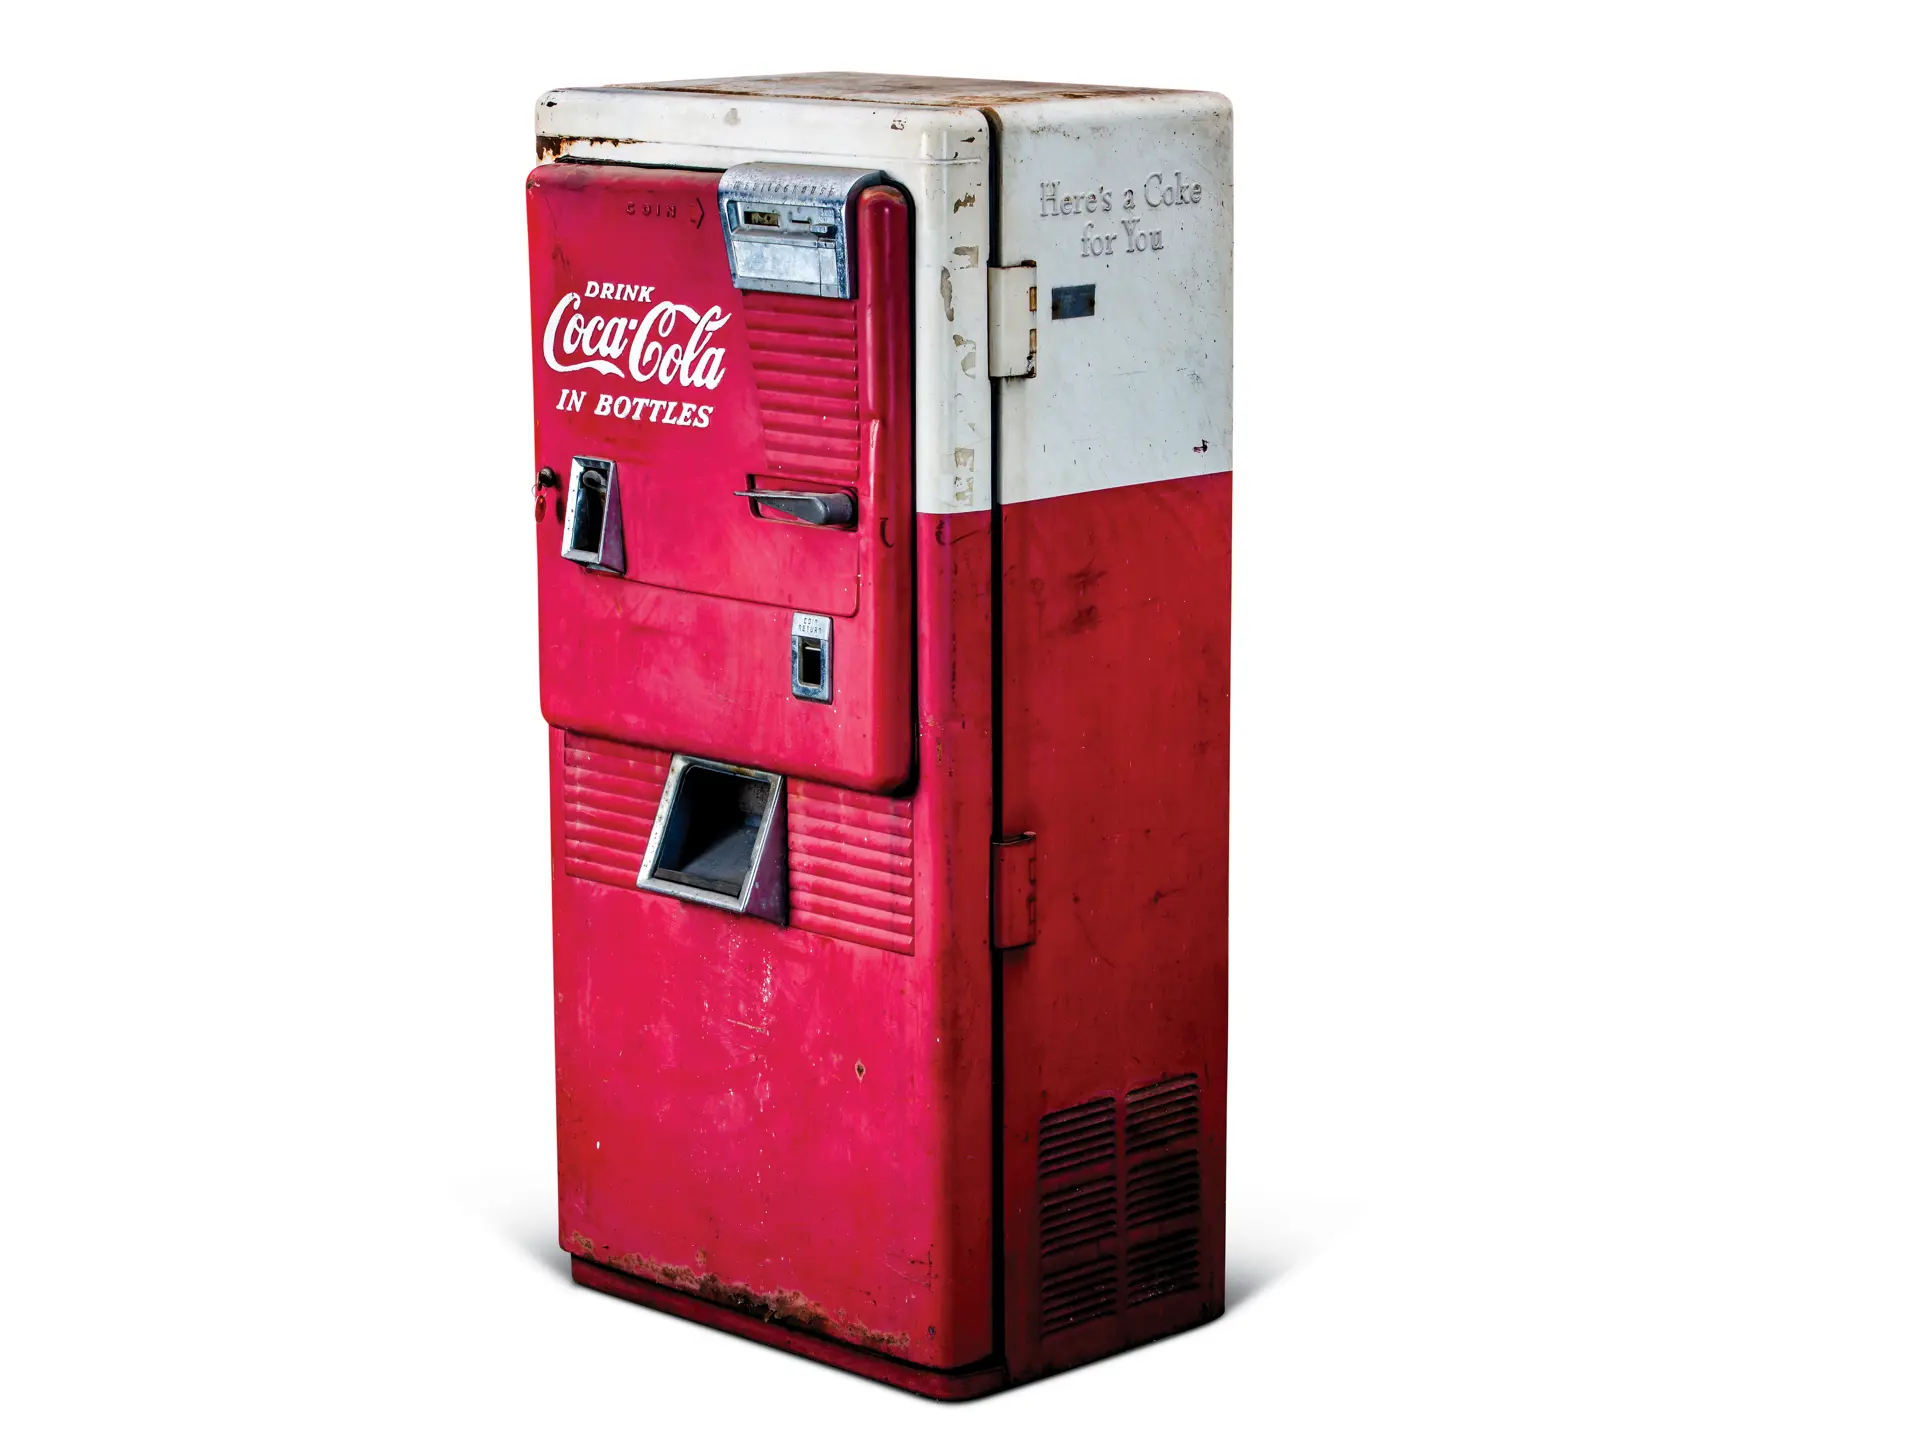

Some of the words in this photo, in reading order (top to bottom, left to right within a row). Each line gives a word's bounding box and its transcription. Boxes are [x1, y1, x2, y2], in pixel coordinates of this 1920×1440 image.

[626, 201, 676, 218] COIN
[1040, 179, 1112, 217] Here's
[1123, 188, 1136, 210] a
[1144, 171, 1202, 208] Coke
[1081, 220, 1118, 257] for
[1121, 216, 1164, 253] You
[584, 281, 655, 302] DRINK
[543, 292, 732, 390] Coca-Cola
[556, 389, 587, 412] IN
[594, 394, 714, 428] BOTTLES
